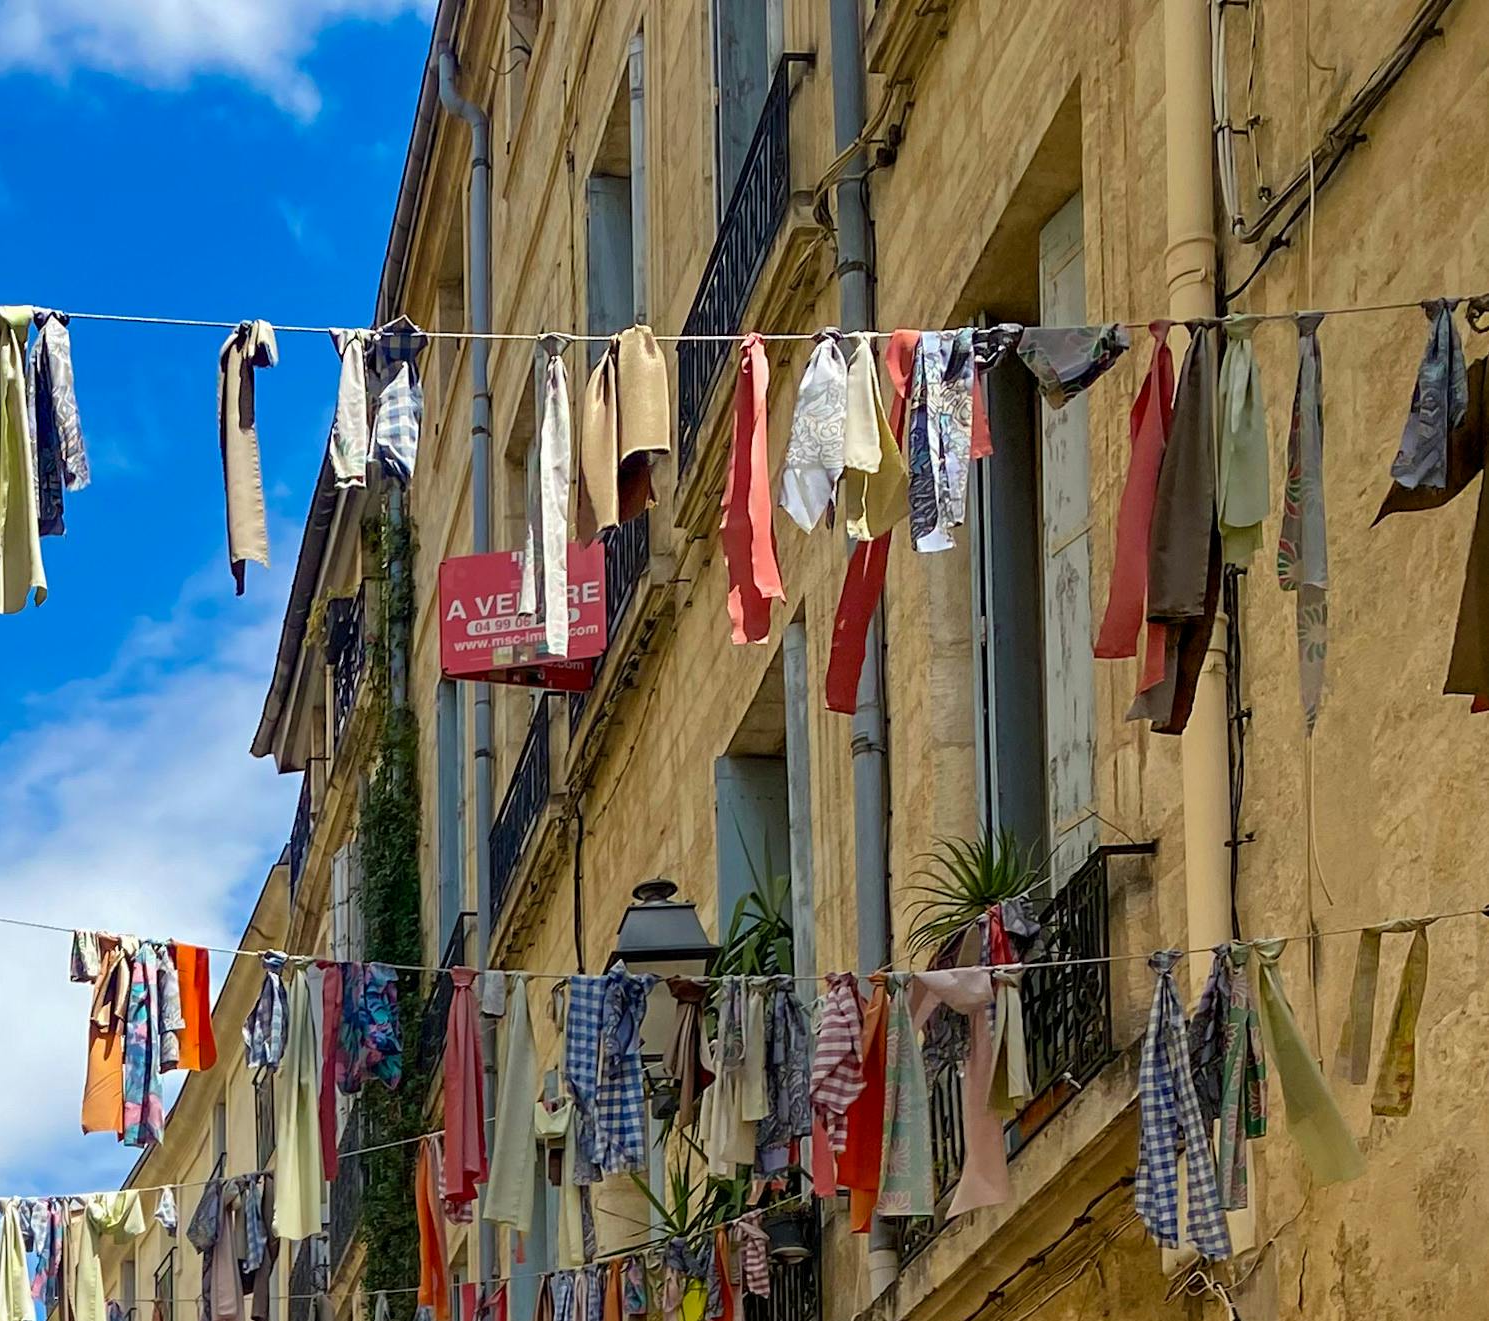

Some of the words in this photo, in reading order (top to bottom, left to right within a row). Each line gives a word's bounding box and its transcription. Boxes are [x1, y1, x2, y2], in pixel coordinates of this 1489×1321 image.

[446, 599, 467, 622] A
[474, 581, 601, 618] VERE
[474, 621, 491, 634] 04
[494, 619, 511, 632] 99
